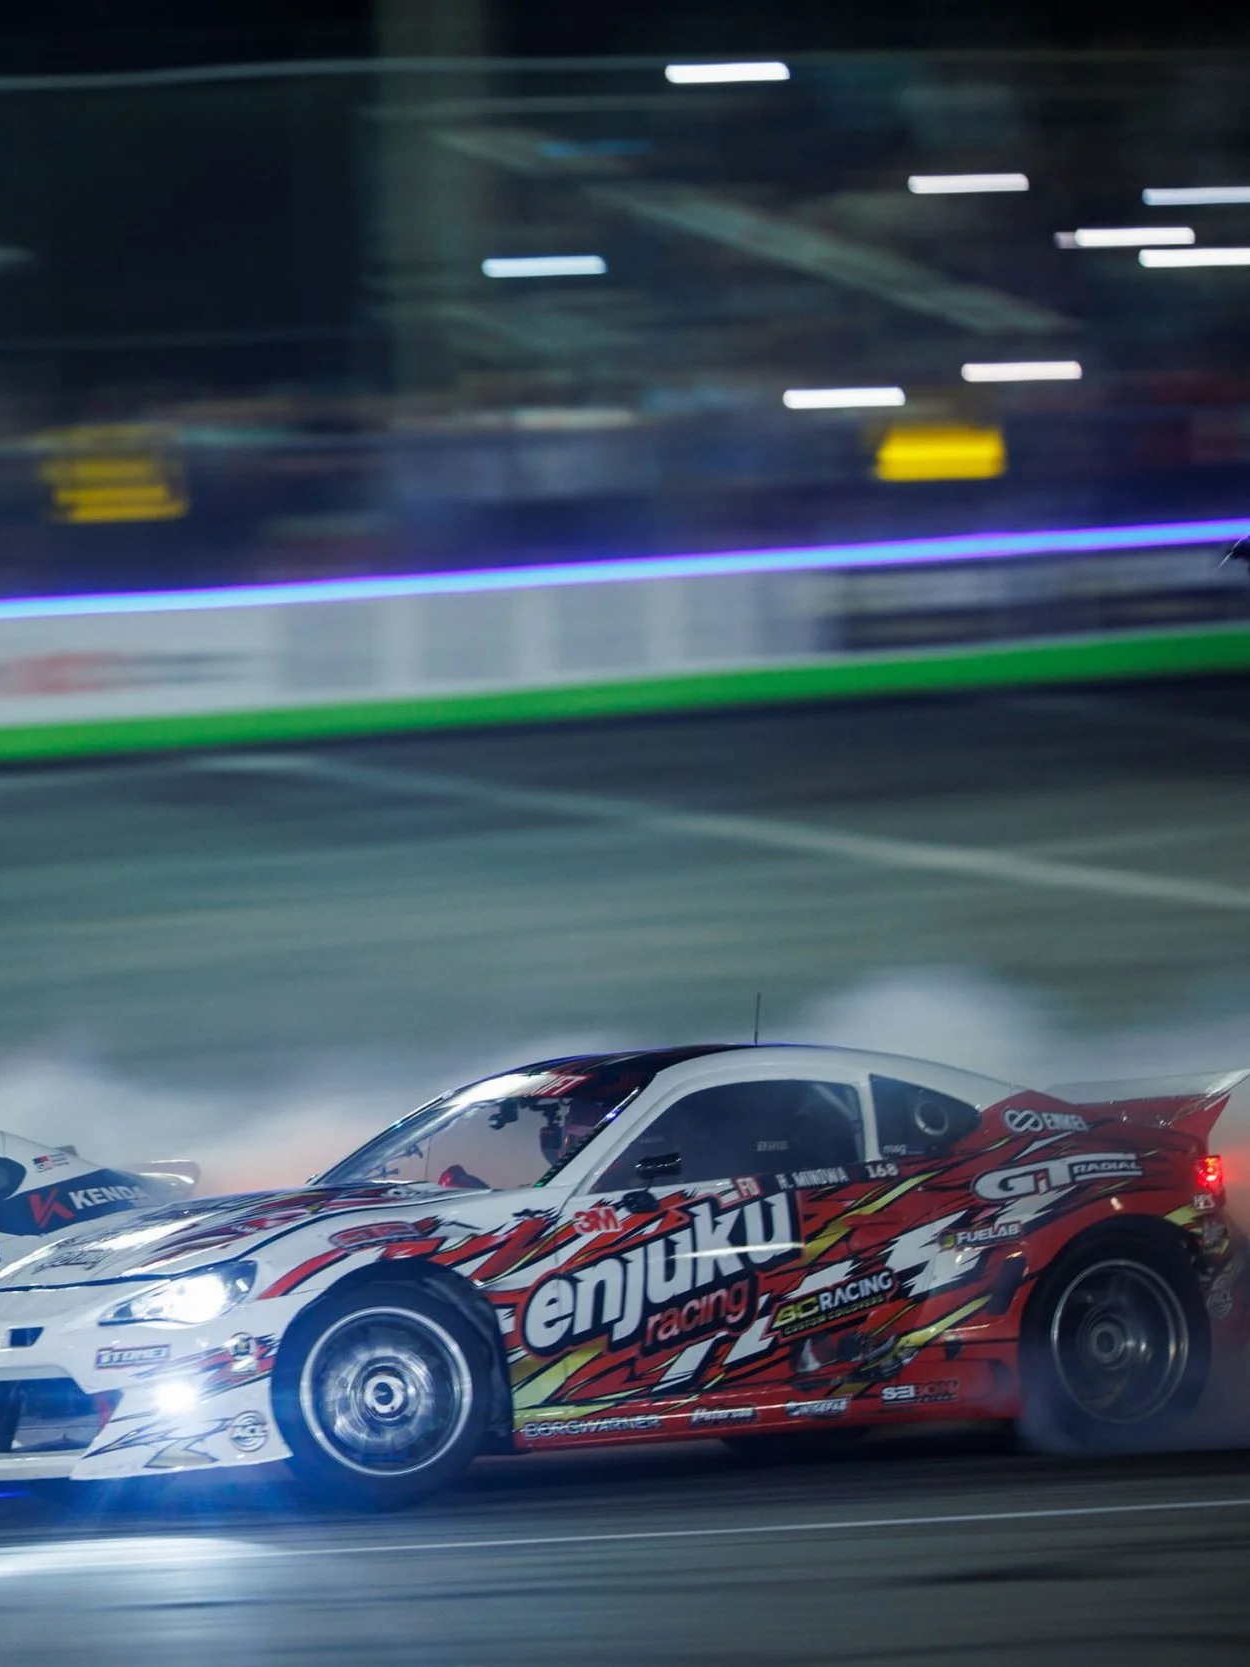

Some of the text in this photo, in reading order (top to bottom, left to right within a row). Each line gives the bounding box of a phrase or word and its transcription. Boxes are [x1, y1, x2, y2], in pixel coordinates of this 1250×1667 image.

[865, 1163, 898, 1179] 168
[1073, 1163, 1142, 1174] RADIAL
[68, 1185, 148, 1210] KENDA
[573, 1207, 622, 1233] 3M
[956, 1223, 1022, 1244] FUELAB
[525, 1192, 791, 1348] enjuku
[818, 1271, 892, 1312] RACING
[646, 1279, 749, 1346] racing
